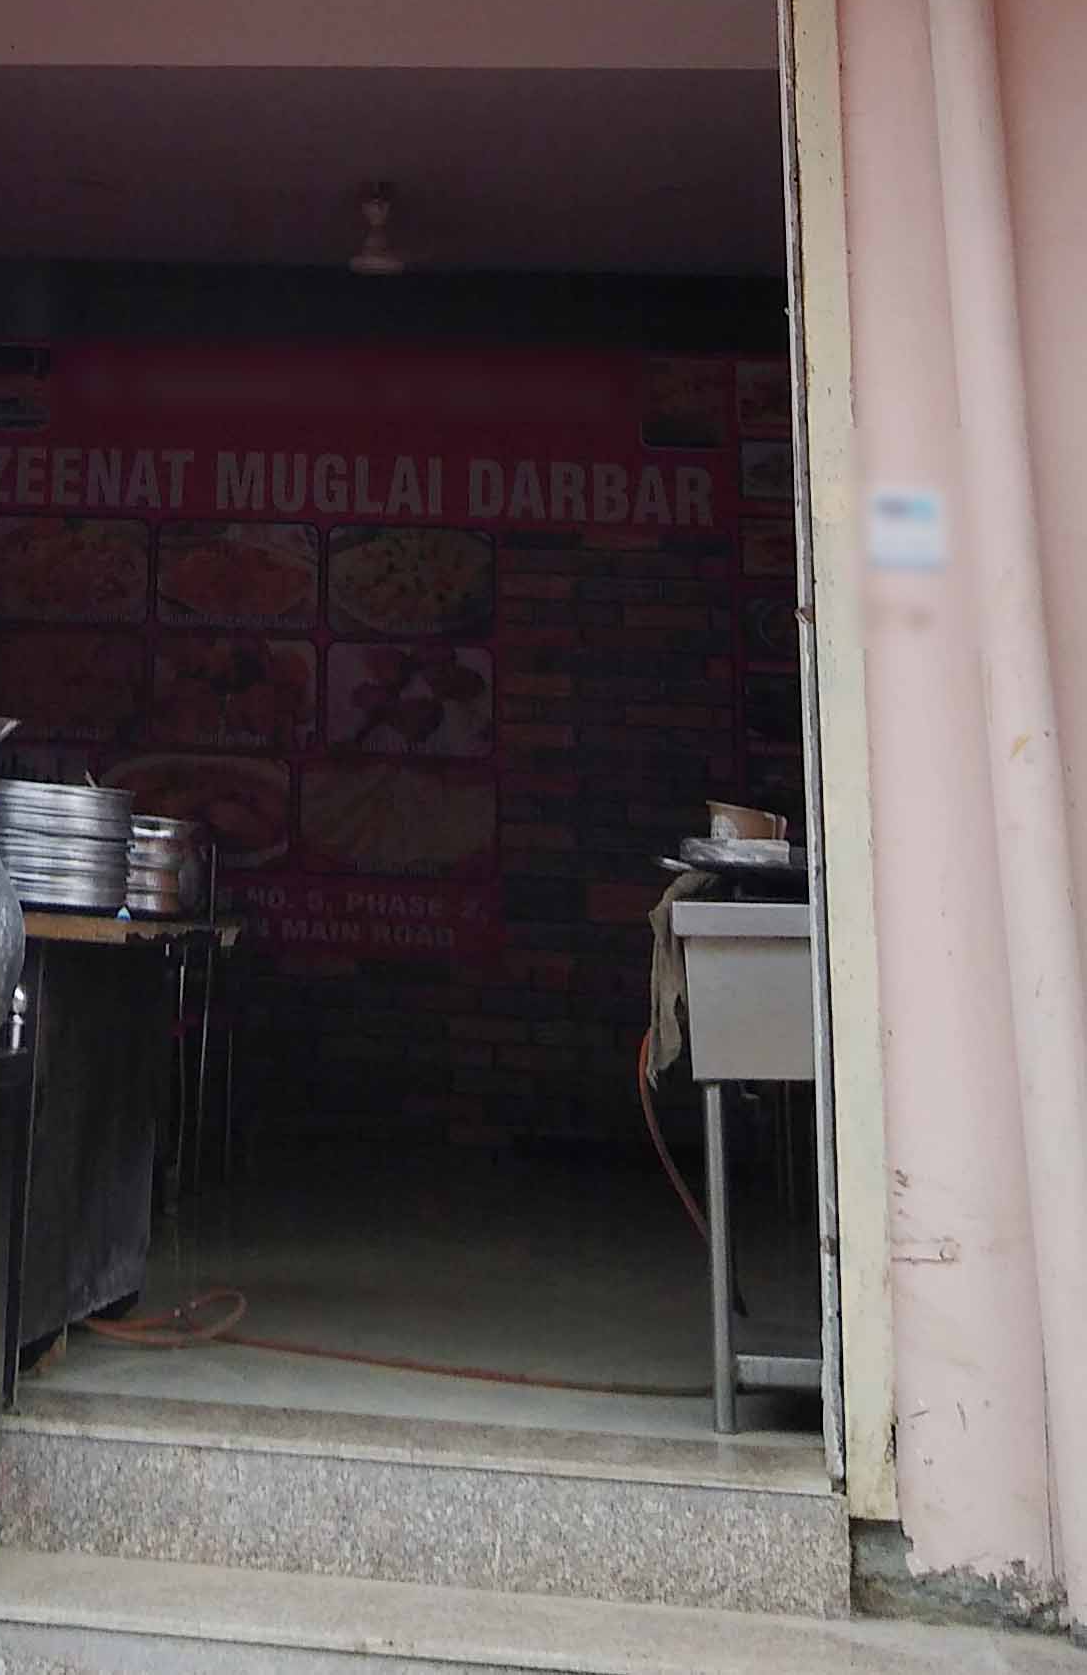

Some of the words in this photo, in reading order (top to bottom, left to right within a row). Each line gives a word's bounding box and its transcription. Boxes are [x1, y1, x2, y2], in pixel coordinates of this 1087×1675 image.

[214, 448, 443, 517] MUGLAI
[467, 456, 714, 526] DARBAR
[281, 917, 363, 943] MAIN
